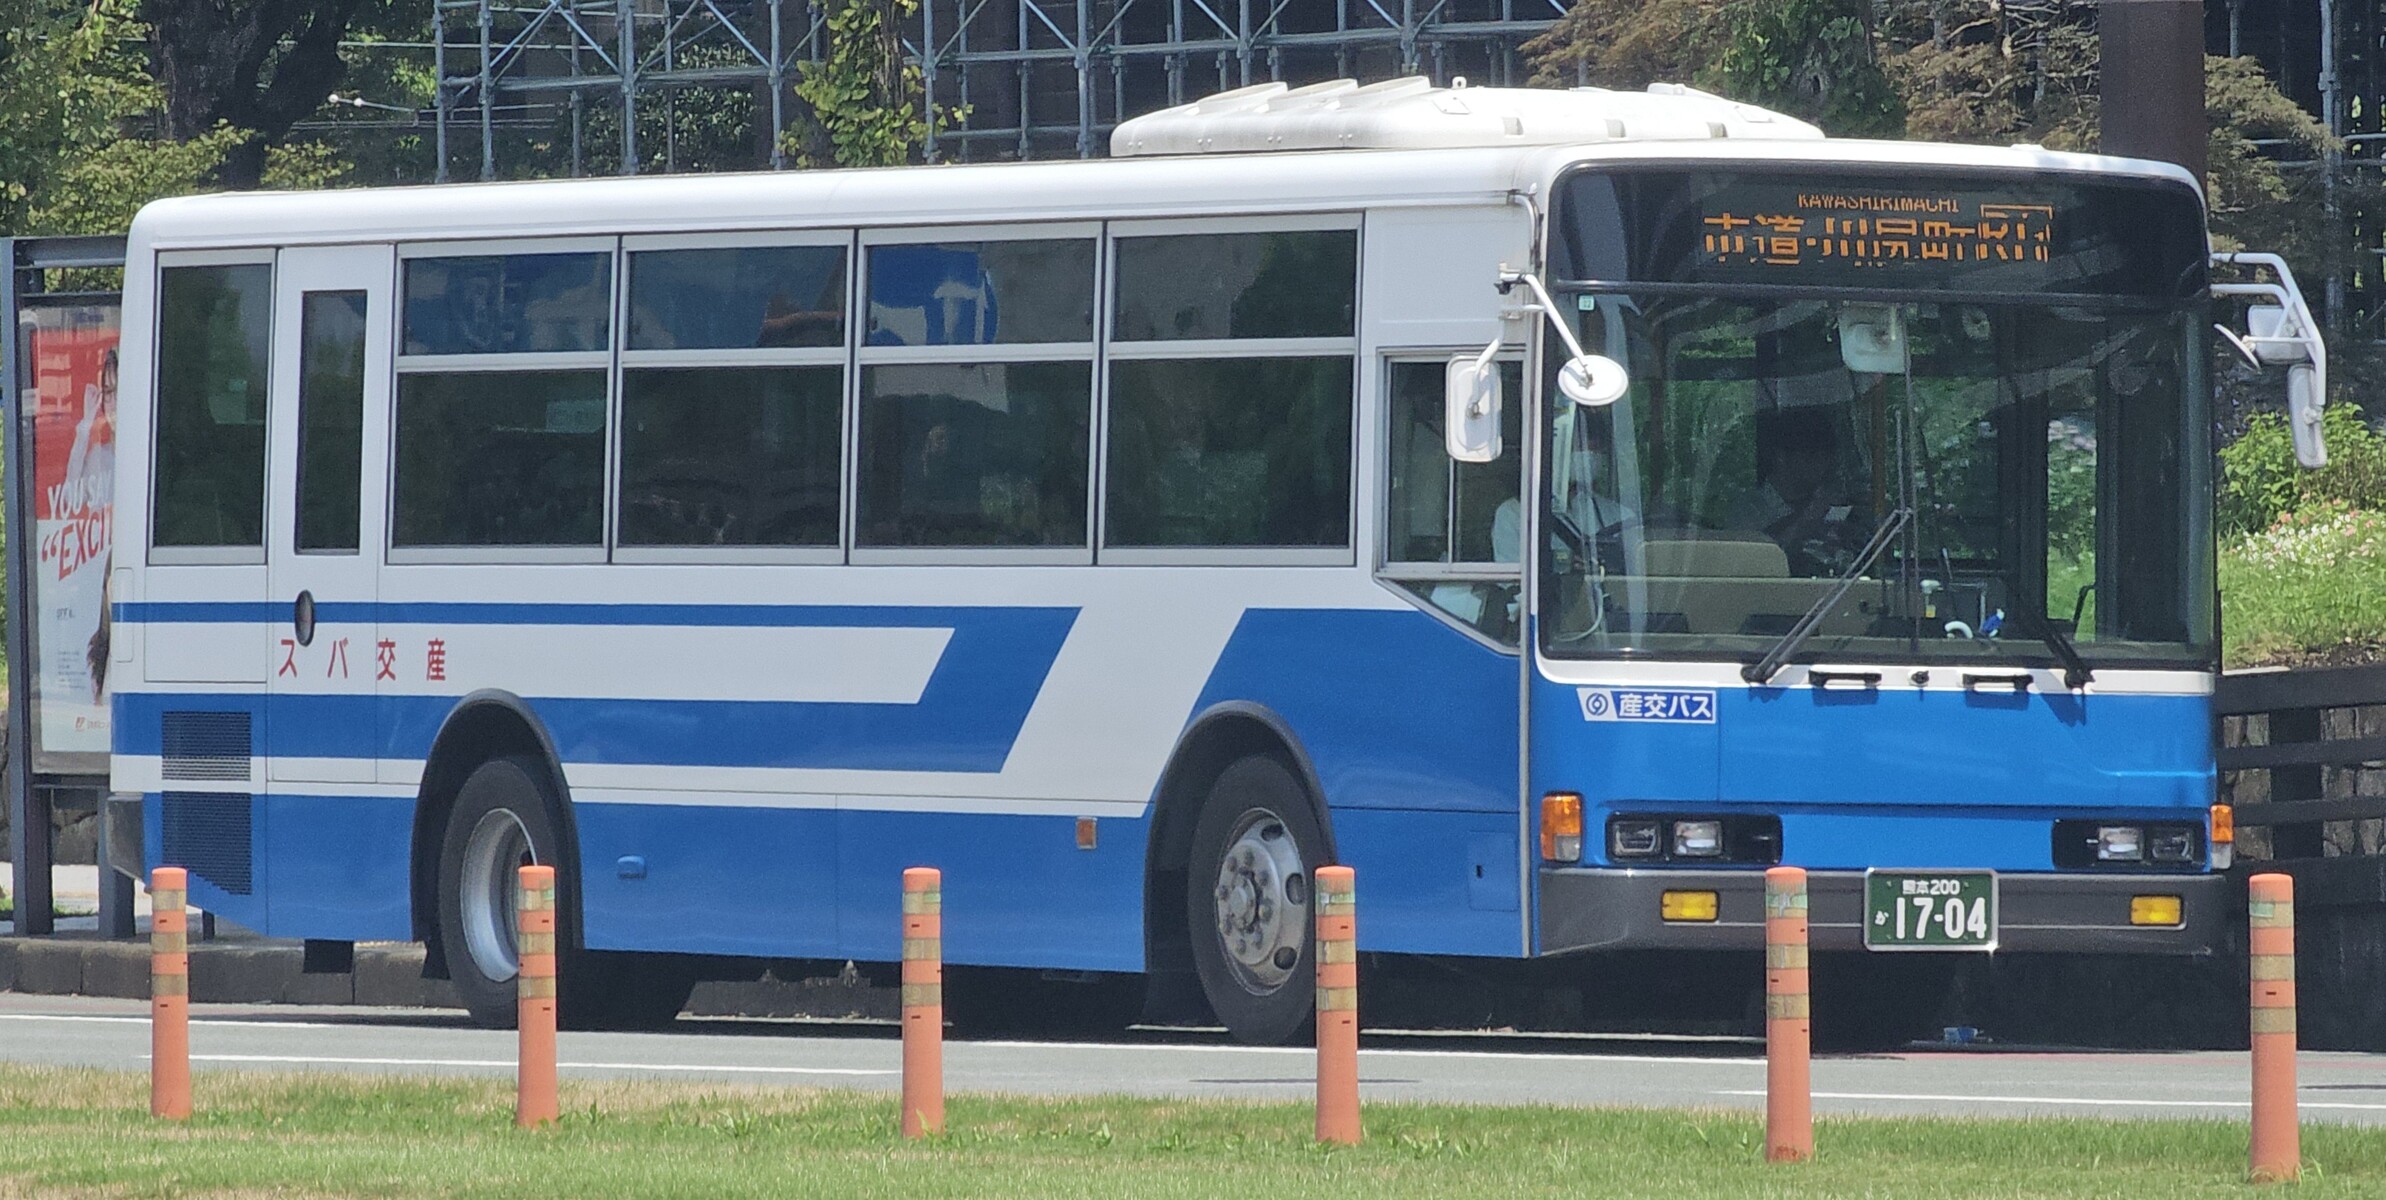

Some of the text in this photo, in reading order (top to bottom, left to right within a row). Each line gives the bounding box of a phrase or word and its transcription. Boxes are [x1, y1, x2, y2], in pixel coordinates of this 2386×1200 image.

[47, 477, 83, 521] YOU
[1618, 692, 1712, 719] 産交バス
[1896, 897, 1988, 940] 17-04
